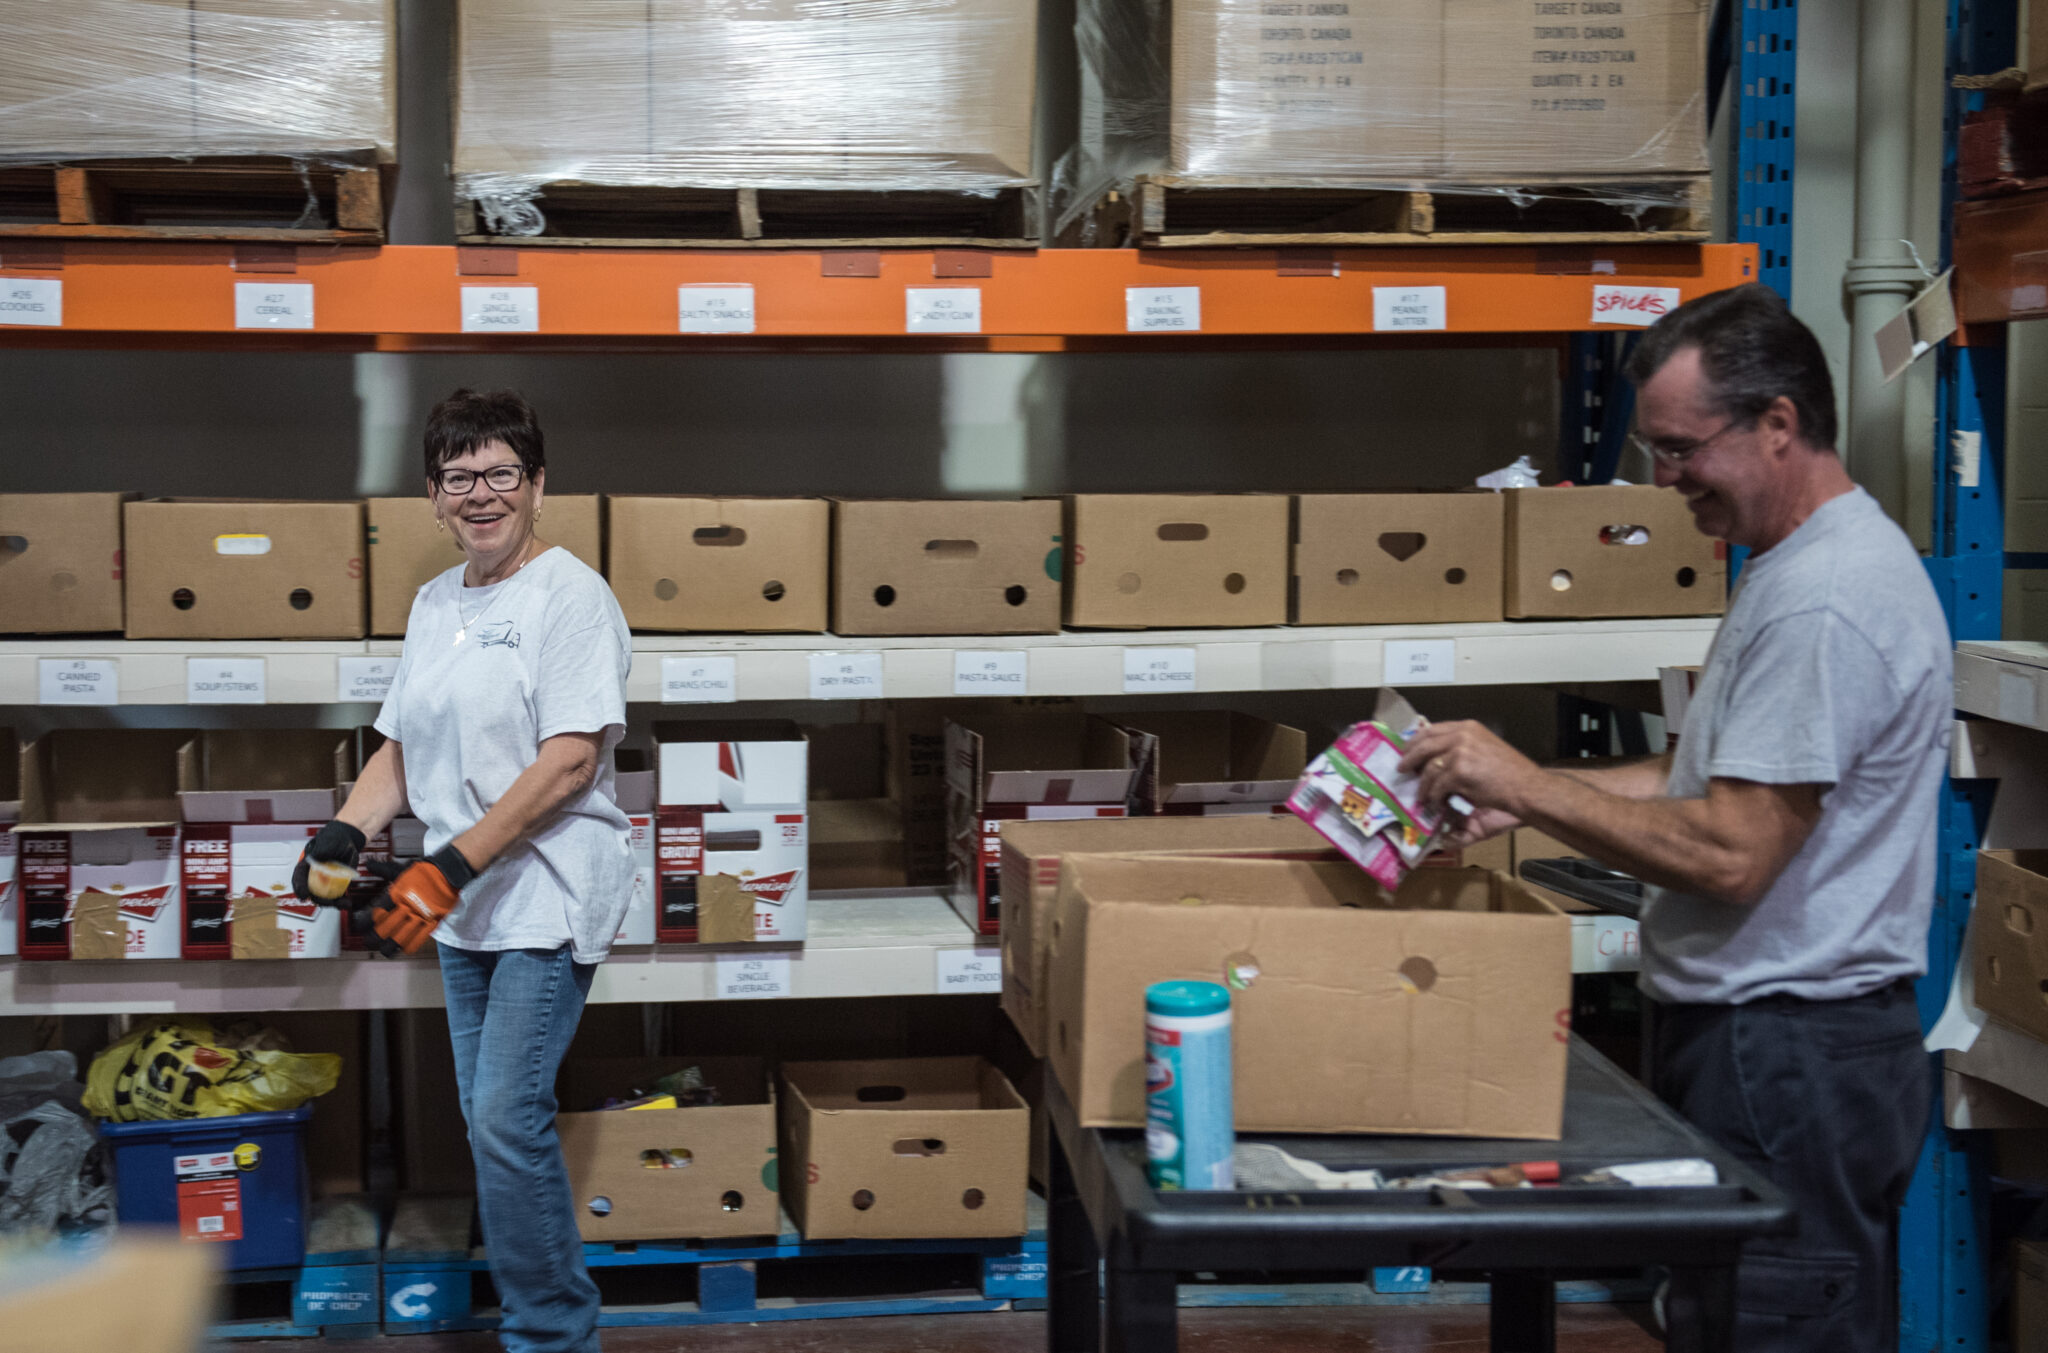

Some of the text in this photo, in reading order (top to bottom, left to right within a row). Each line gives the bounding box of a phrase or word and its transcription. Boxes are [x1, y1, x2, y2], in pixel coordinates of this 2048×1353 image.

[1308, 4, 1349, 16] CANADA
[1534, 2, 1622, 14] TARGET CANADA
[1311, 28, 1351, 40] CANADA
[1583, 26, 1625, 39] CANADA
[1608, 74, 1623, 87] EA
[255, 305, 294, 315] CEREAL
[481, 303, 518, 313] SINGLE
[1145, 306, 1182, 315] BAKING
[1392, 305, 1429, 315] PEANUT
[680, 310, 752, 319] SALTY SNACKS
[481, 315, 520, 325] SNACKS
[1144, 317, 1185, 327] SUPPLIES
[1392, 317, 1428, 326] BUTTER
[1409, 665, 1429, 674] JAM
[58, 672, 102, 681] CANNED
[355, 676, 394, 686] CANNE
[819, 677, 839, 686] DRY
[959, 673, 1022, 682] PASTA SAUCE
[1125, 673, 1147, 681] MAC
[1159, 672, 1193, 681] CHEESE
[63, 683, 96, 693] PASTA
[23, 840, 67, 853] FREE
[184, 840, 229, 853] FREE
[658, 846, 702, 859] GRATUIT
[184, 858, 228, 866] MINI AMP
[23, 865, 68, 873] SPEAKER
[125, 929, 146, 945] DE
[736, 972, 769, 981] SINGLE
[946, 975, 969, 983] BABY
[727, 983, 781, 993] BEVERAGES
